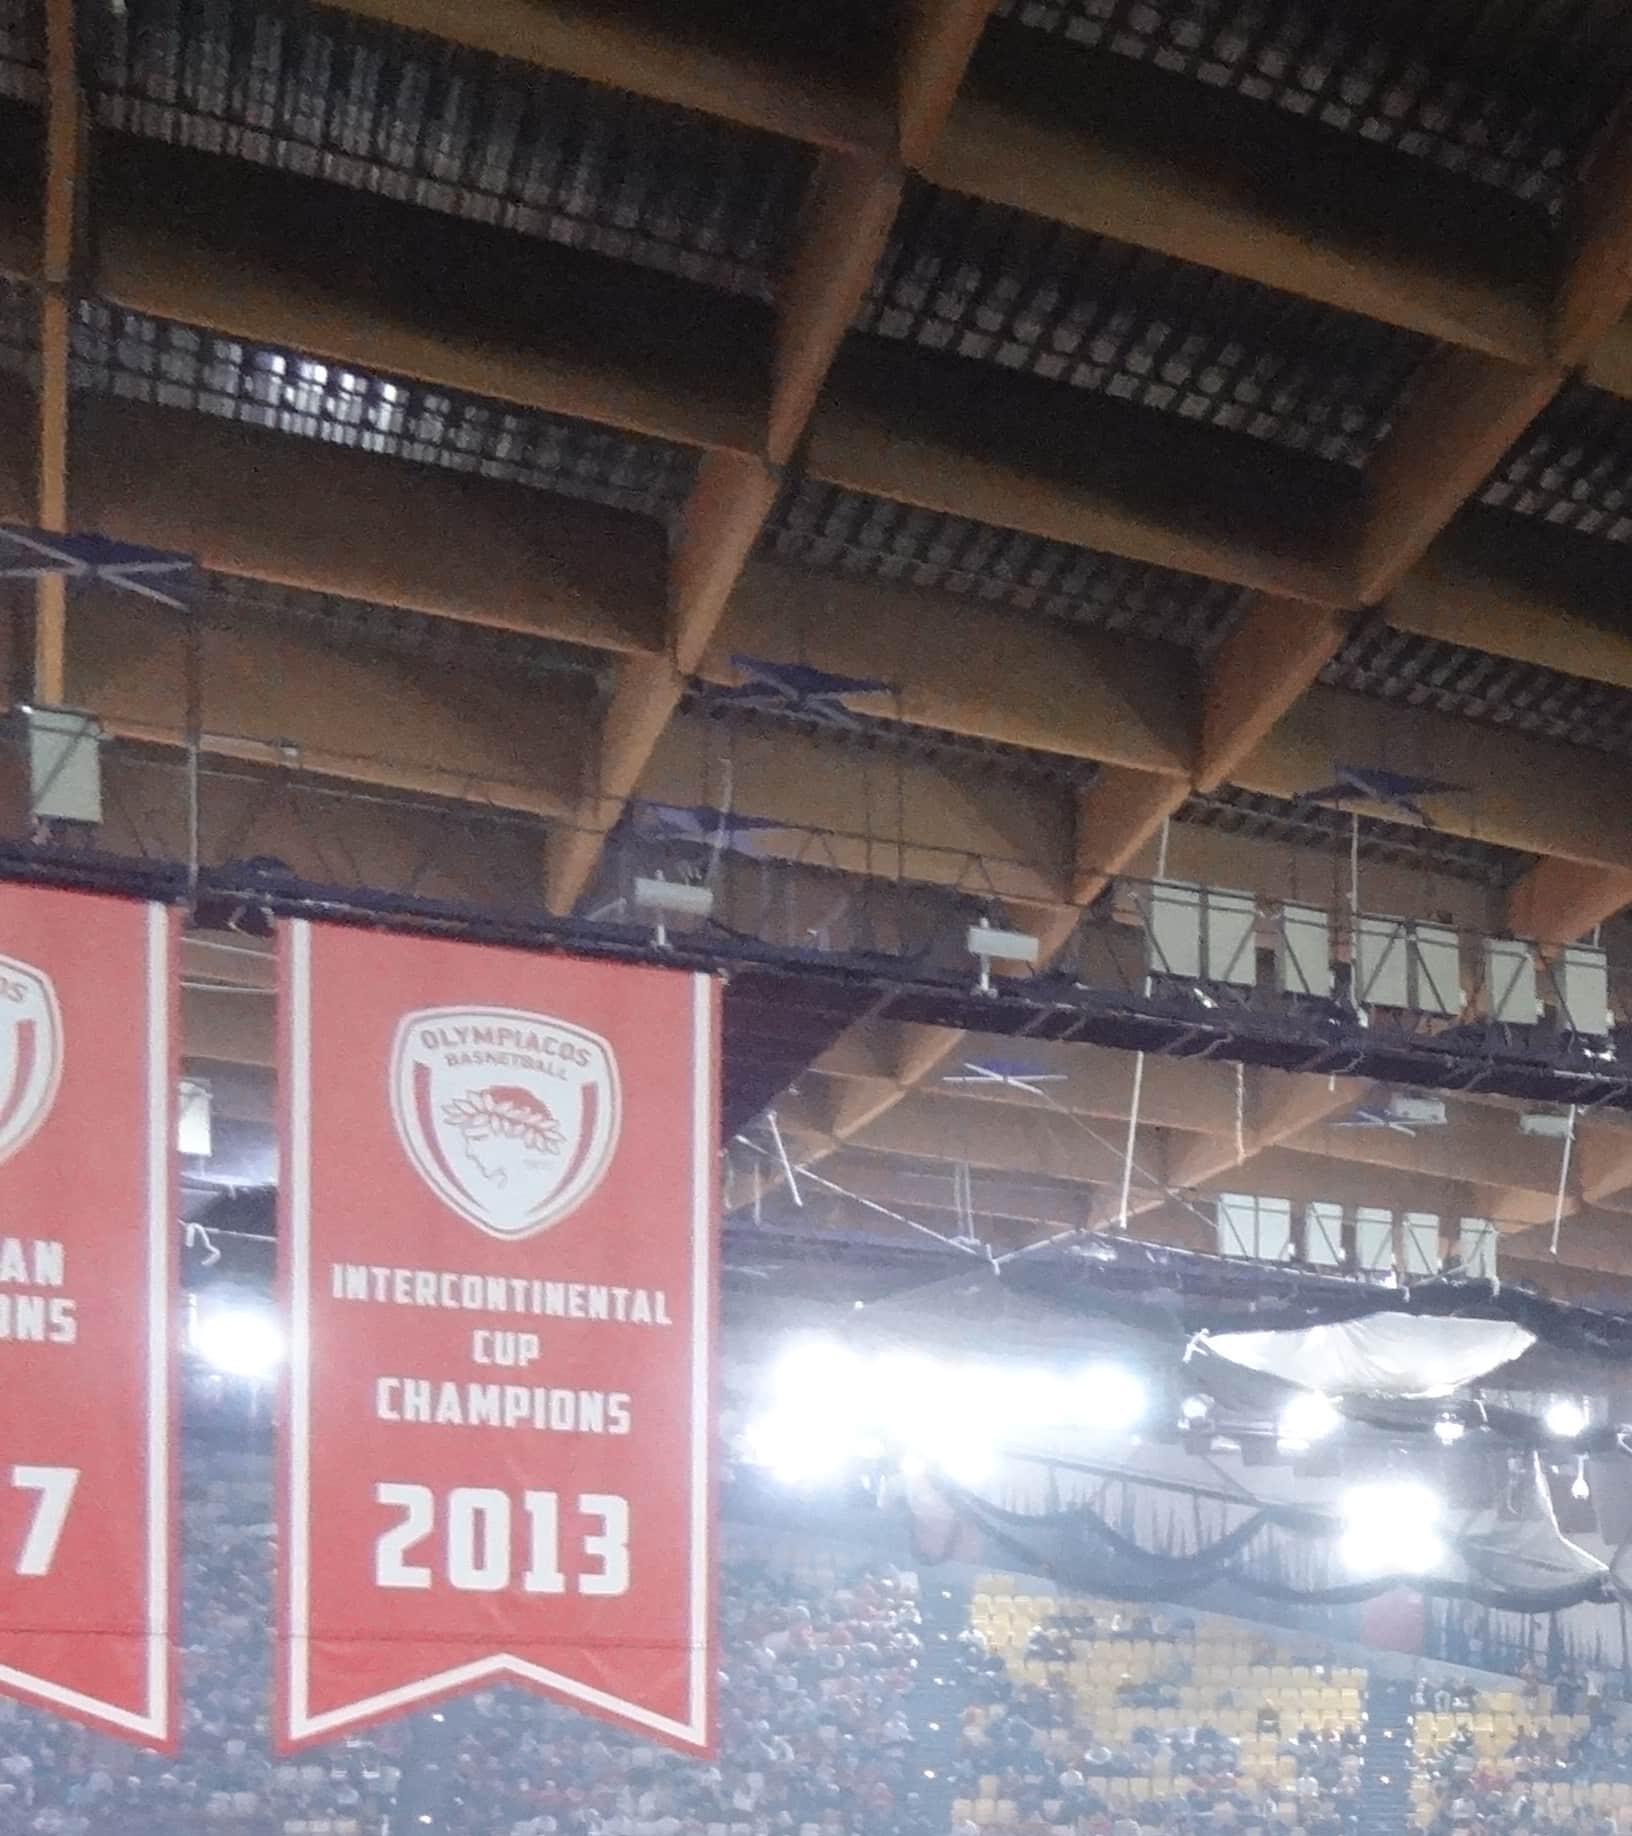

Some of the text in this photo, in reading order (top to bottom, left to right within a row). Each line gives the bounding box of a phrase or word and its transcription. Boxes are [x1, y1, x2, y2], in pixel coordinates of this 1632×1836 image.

[419, 1026, 592, 1068] OLYMPIACOS
[444, 1051, 568, 1082] BASKETBALL
[330, 1263, 673, 1325] INTERCONTINENTAL
[471, 1329, 541, 1367] CUP
[375, 1376, 632, 1435] CHAMPIONS
[12, 1465, 81, 1576] 7
[375, 1482, 630, 1596] 2013
